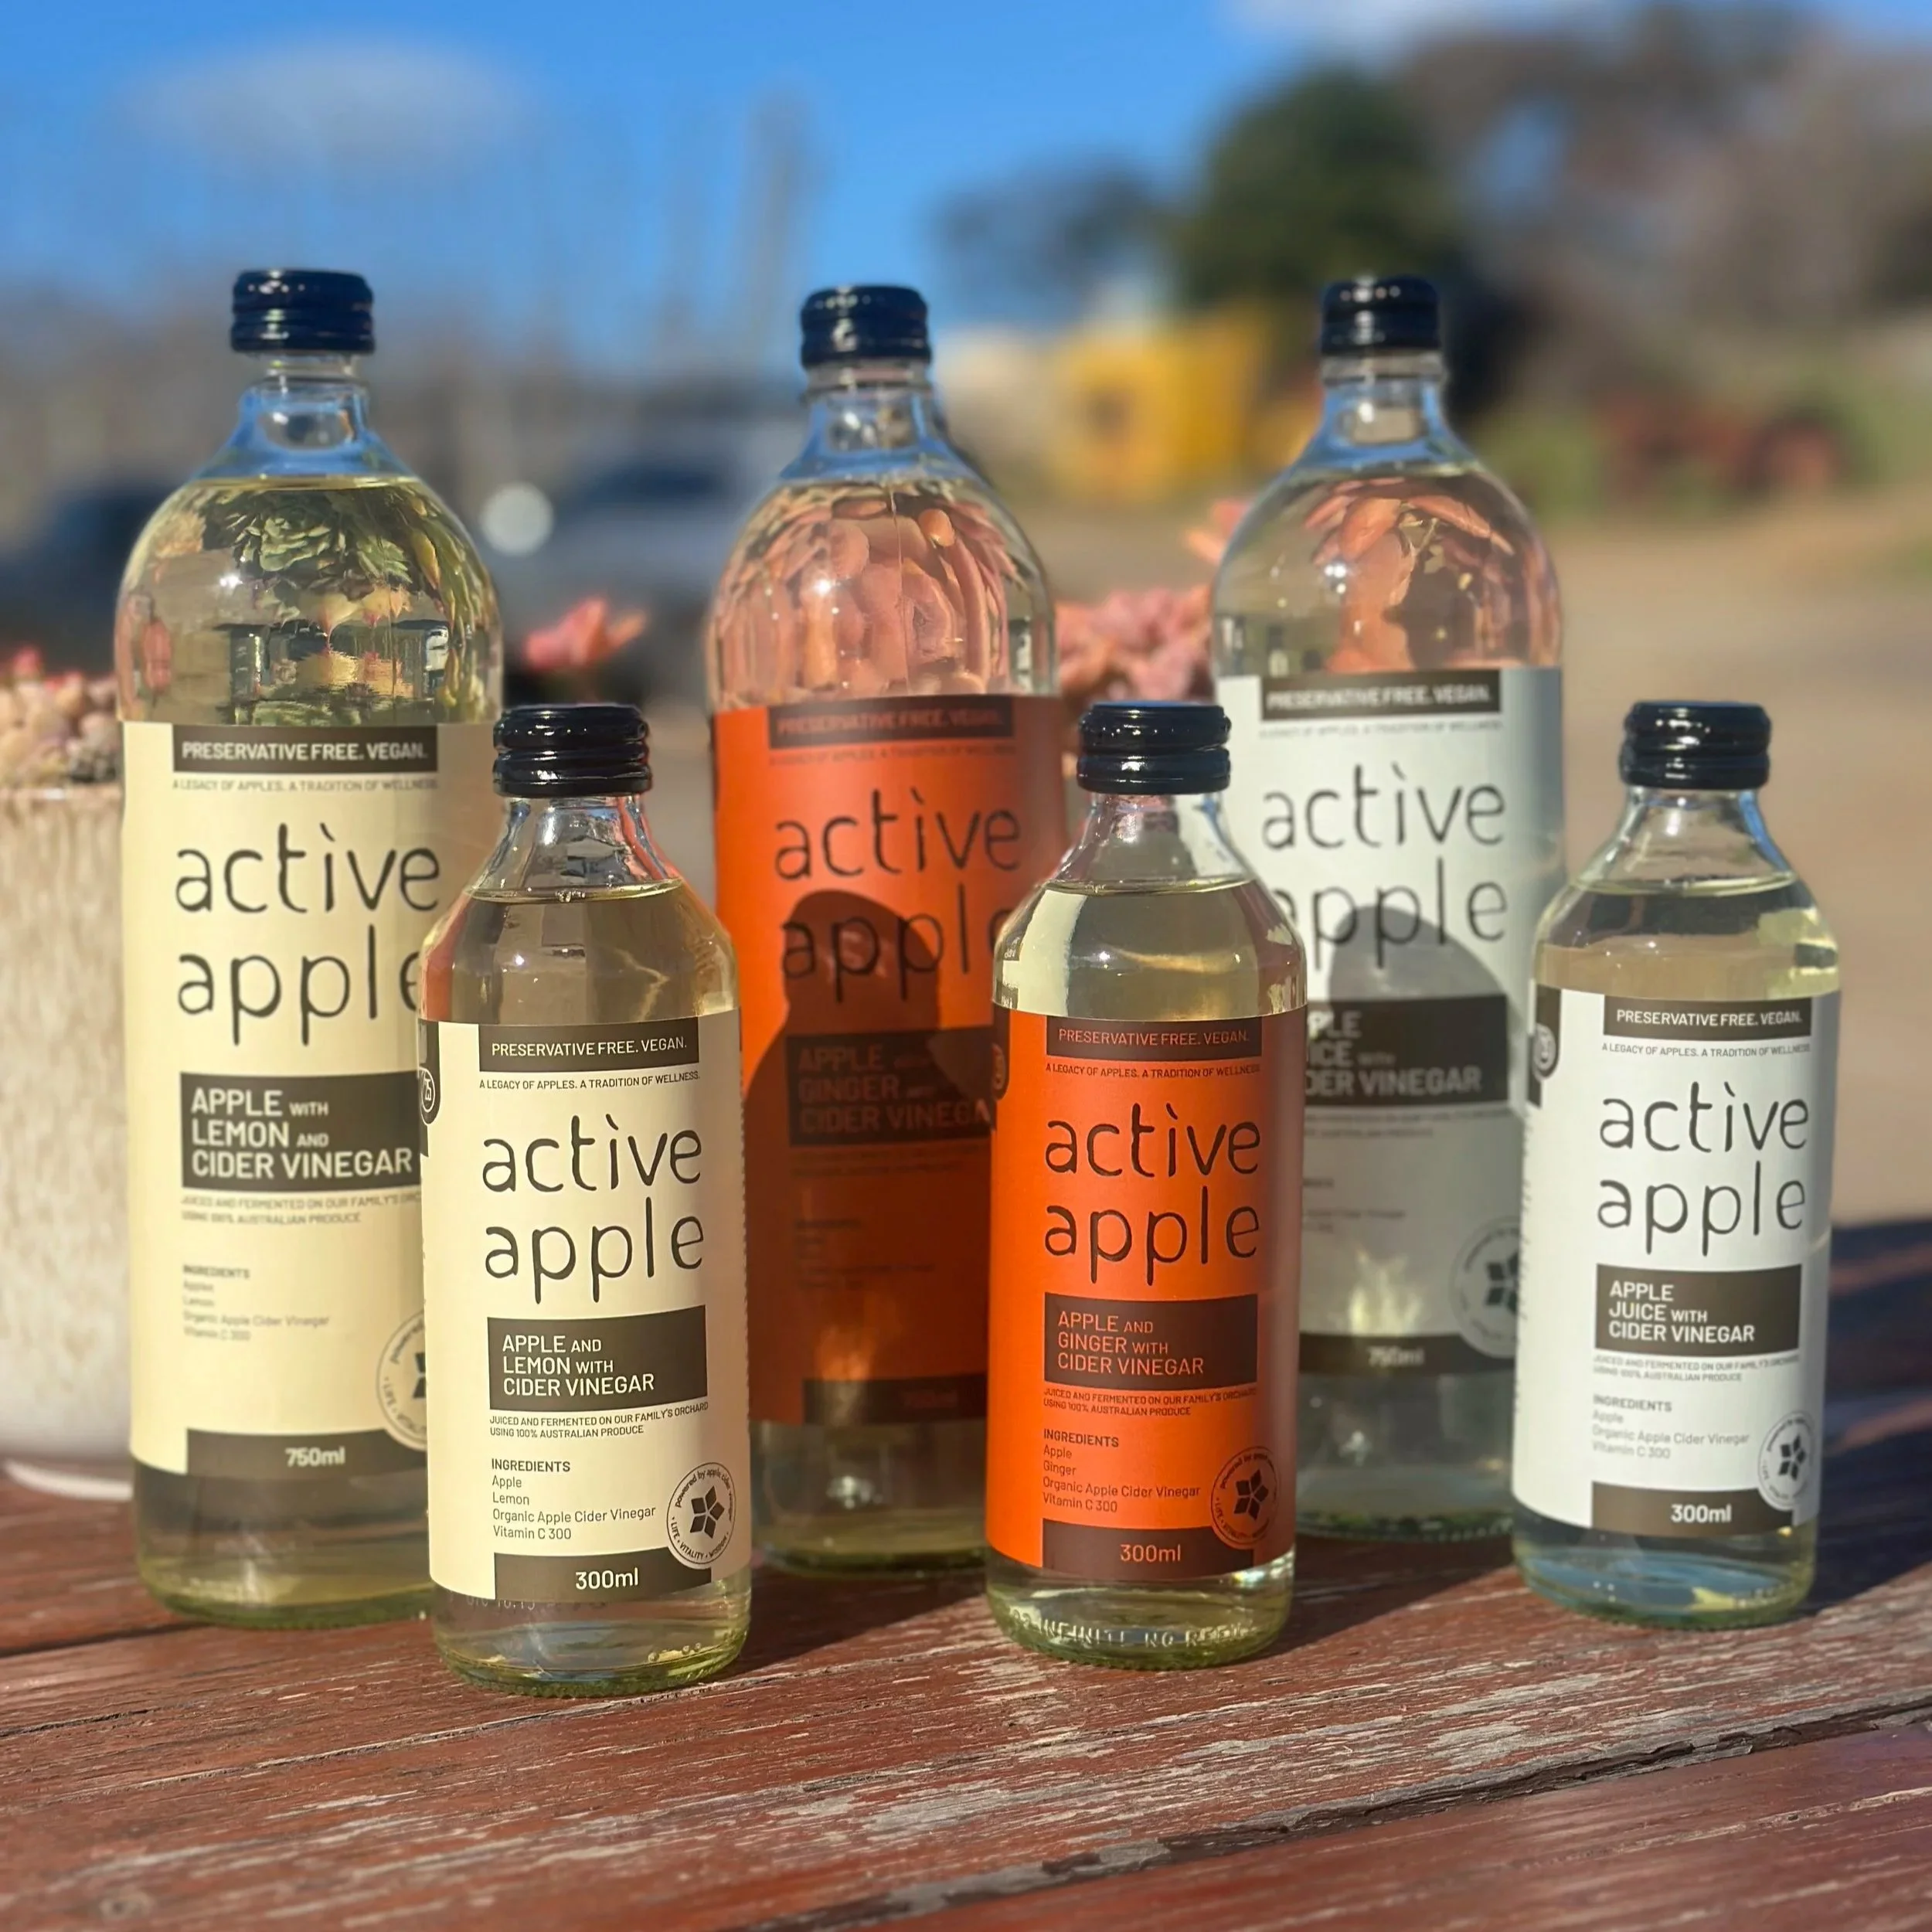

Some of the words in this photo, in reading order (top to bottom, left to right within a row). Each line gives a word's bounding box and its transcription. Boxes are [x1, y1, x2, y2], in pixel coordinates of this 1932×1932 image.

[182, 741, 308, 760] PRESERVATIVE
[311, 743, 365, 760] FREE.
[366, 742, 429, 760] VEGAN.
[1307, 1010, 1362, 1039] PLE
[1617, 1009, 1718, 1026] PRESERVATIVE
[1720, 1013, 1758, 1026] FREE.
[1760, 1011, 1802, 1026] VEGAN.
[492, 1043, 595, 1056] PRESERVATIVE
[597, 1041, 639, 1056] FREE.
[641, 1036, 687, 1052] VEGAN.
[1059, 1029, 1158, 1046] PRESERVATIVE
[1161, 1033, 1200, 1046] FREE.
[1203, 1029, 1249, 1044] VEGAN.
[1609, 1043, 1643, 1055] LEGACY
[1646, 1046, 1658, 1056] OF
[1702, 1048, 1708, 1057] A
[1710, 1048, 1757, 1058] TRADITION
[1046, 1063, 1051, 1072] A
[1053, 1063, 1085, 1076] LEGACY
[1087, 1066, 1098, 1076] OF
[1100, 1067, 1140, 1078] APPLES.
[1141, 1069, 1148, 1078] A
[1151, 1068, 1200, 1079] TRADITION
[1202, 1066, 1213, 1077] OF
[479, 1079, 485, 1089] A
[487, 1080, 519, 1090] LEGACY
[522, 1080, 534, 1090] OF
[536, 1080, 577, 1090] APPLES.
[580, 1079, 587, 1089] A
[588, 1077, 640, 1089] TRADITION
[641, 1076, 653, 1086] OF
[190, 1087, 283, 1117] APPLE
[289, 1101, 328, 1117] WITH
[886, 1098, 991, 1131] VINEGA
[192, 1118, 290, 1148] LEMON
[296, 1132, 328, 1148] AND
[192, 1150, 274, 1179] CIDER
[280, 1148, 413, 1179] VINEGAR
[1597, 1161, 1805, 1257] apple
[1045, 1185, 1260, 1286] apple
[485, 1196, 704, 1304] apple
[1609, 1280, 1674, 1301] APPLE
[1608, 1301, 1666, 1321] JUICE
[1670, 1309, 1708, 1323] WITH
[1058, 1310, 1119, 1332] APPLE
[1124, 1321, 1154, 1334] AND
[1608, 1320, 1667, 1342] CIDER
[1670, 1324, 1755, 1344] VINEGAR
[502, 1335, 566, 1353] APPLE
[570, 1338, 602, 1352] AND
[1057, 1331, 1128, 1354] GINGER
[1132, 1342, 1168, 1355] WITH
[503, 1355, 571, 1376] LEMON
[575, 1359, 614, 1374] WITH
[1057, 1352, 1112, 1375] CIDER
[1117, 1357, 1203, 1376] VINEGAR
[503, 1377, 560, 1396] CIDER
[565, 1372, 655, 1397] VINEGAR
[1072, 1391, 1090, 1401] AND
[1092, 1393, 1146, 1405] FERMENTED
[1148, 1395, 1161, 1405] ON
[1163, 1394, 1182, 1404] OUR
[1593, 1394, 1672, 1412] INGREDIENTS
[489, 1415, 519, 1426] JUICED
[521, 1417, 539, 1427] AND
[541, 1416, 597, 1427] FERMENTED
[599, 1415, 612, 1425] ON
[614, 1413, 633, 1424] OUR
[635, 1408, 673, 1423] FAMILY'S
[675, 1401, 709, 1417] ORCHARD
[1090, 1404, 1148, 1417] AUSTRALIAN
[1149, 1406, 1191, 1417] PRODUCE
[490, 1427, 515, 1437] USING
[516, 1428, 538, 1438] 100%
[539, 1428, 598, 1439] AUSTRALIAN
[600, 1425, 644, 1437] PRODUCE
[1043, 1428, 1119, 1447] INGREDIENTS
[1638, 1430, 1671, 1444] Apple
[1673, 1432, 1706, 1444] Cider
[1709, 1433, 1750, 1447] Vinegar
[284, 1447, 345, 1467] 750ml
[1043, 1444, 1072, 1459] Apple
[1637, 1446, 1645, 1458] C
[492, 1458, 571, 1472] INGREDIENTS
[1043, 1460, 1077, 1476] Ginger
[492, 1475, 522, 1489] Apple
[1043, 1476, 1083, 1494] Organic
[1085, 1484, 1118, 1498] Apple
[1121, 1485, 1153, 1498] Cider
[1155, 1485, 1200, 1500] Vinegar
[492, 1492, 530, 1505] Lemon
[1043, 1492, 1083, 1510] Vitamin
[1085, 1499, 1094, 1511] C
[1095, 1499, 1118, 1512] 300
[492, 1509, 535, 1526] Organic
[537, 1510, 572, 1526] Apple
[574, 1509, 607, 1523] Cider
[611, 1507, 656, 1522] Vinegar
[1671, 1503, 1732, 1522] 300ml
[493, 1526, 535, 1539] Vitamin
[538, 1528, 546, 1540] C
[549, 1528, 572, 1540] 300
[679, 1542, 704, 1560] VITALITY
[1120, 1544, 1181, 1563] 300ml
[575, 1567, 639, 1590] 300ml
